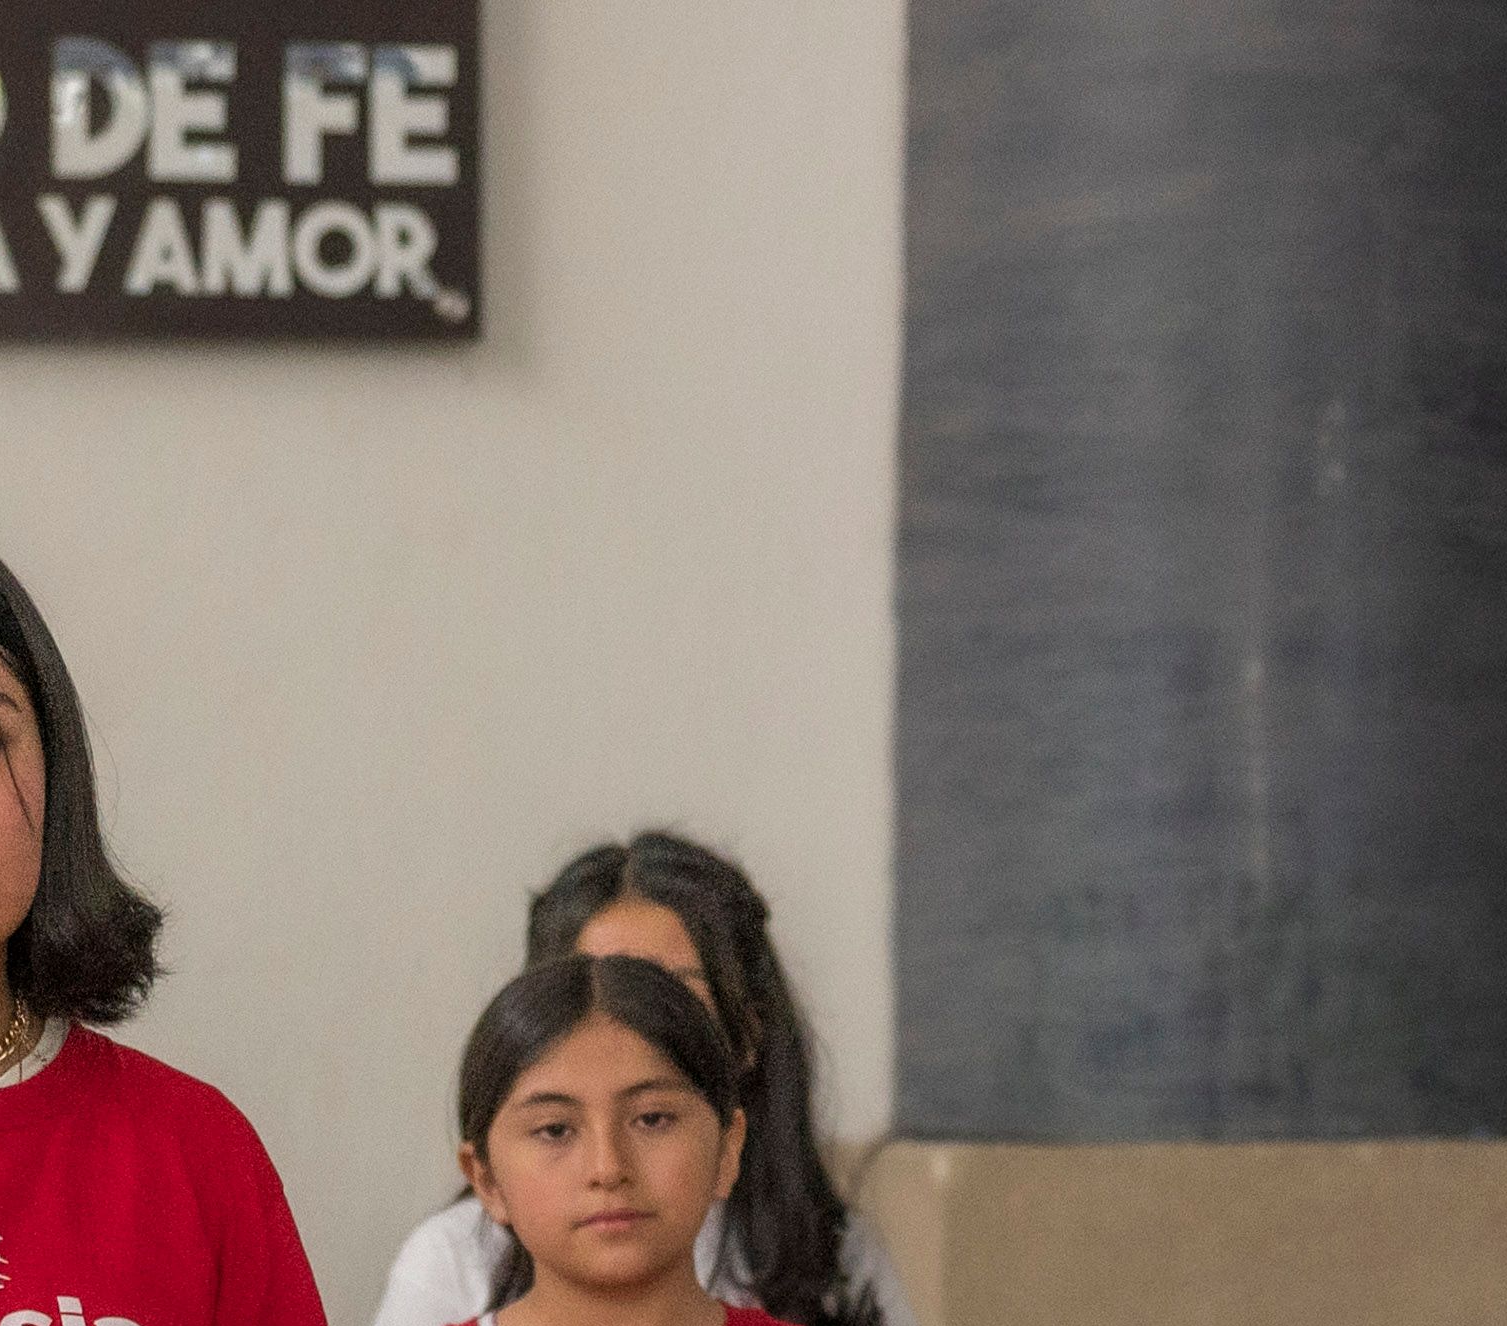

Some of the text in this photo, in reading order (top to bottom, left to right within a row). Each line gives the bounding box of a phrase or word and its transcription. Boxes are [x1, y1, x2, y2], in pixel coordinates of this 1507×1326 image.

[50, 37, 237, 182] DE
[282, 42, 458, 184] FE
[40, 196, 116, 292] Y
[126, 199, 438, 297] AMOR
